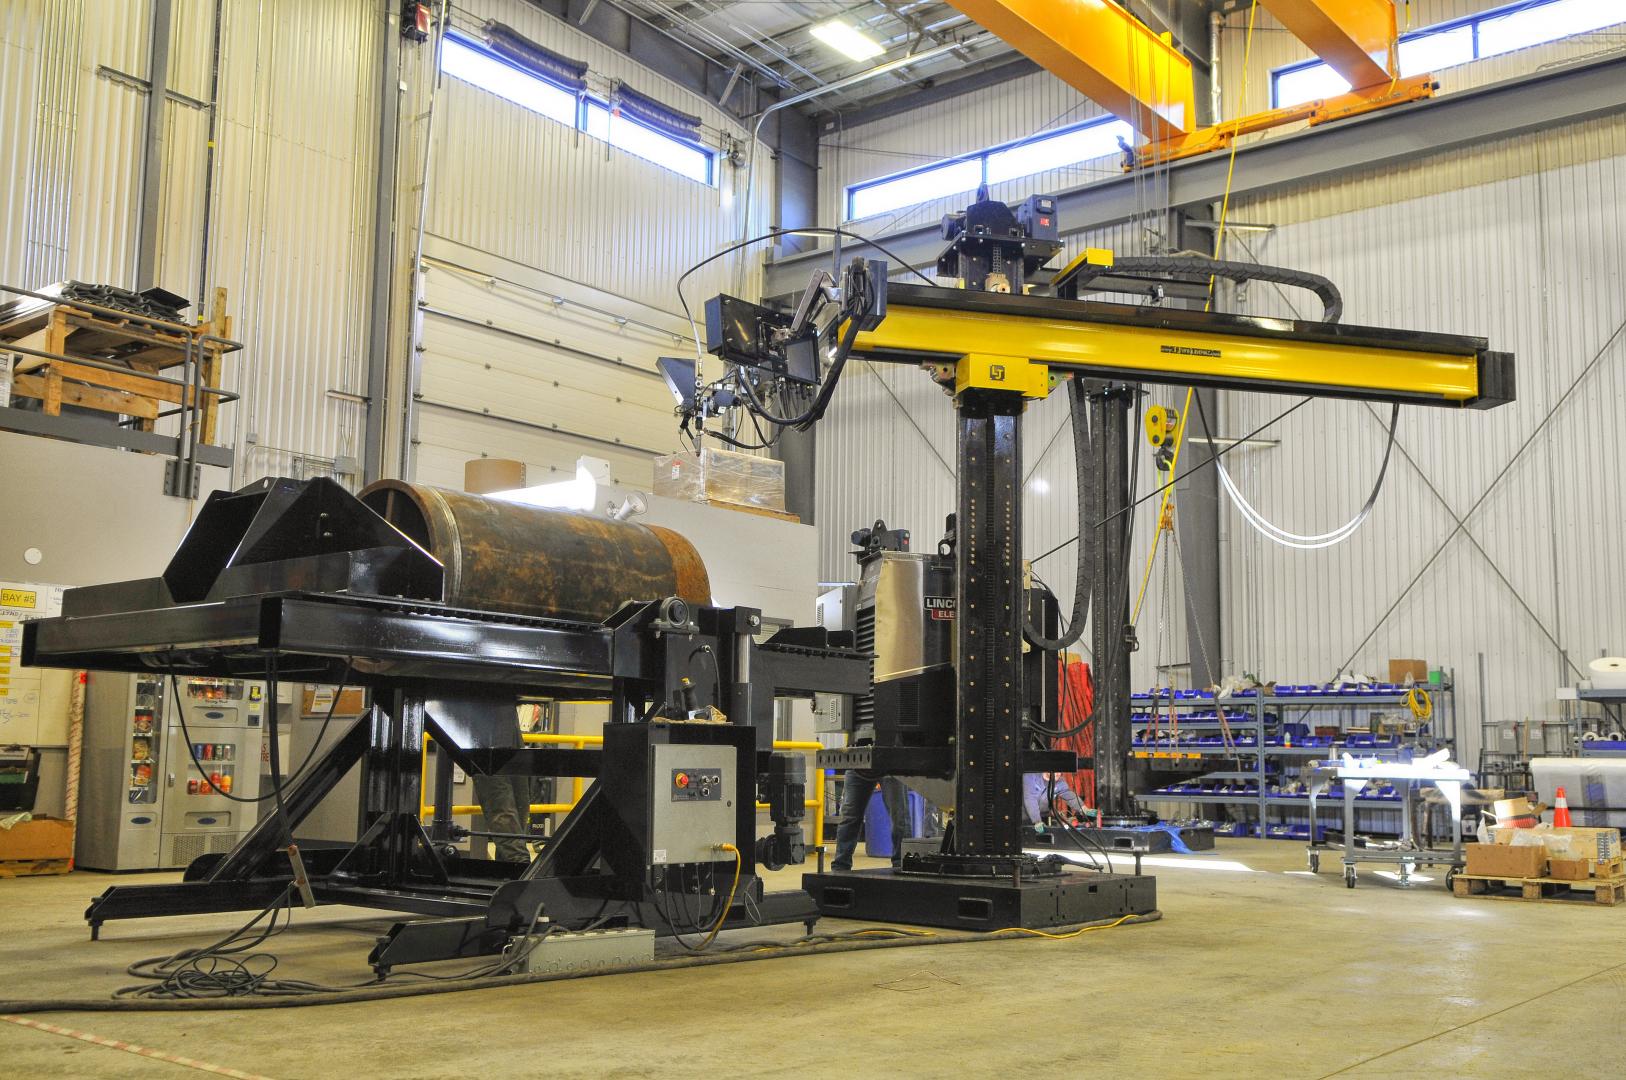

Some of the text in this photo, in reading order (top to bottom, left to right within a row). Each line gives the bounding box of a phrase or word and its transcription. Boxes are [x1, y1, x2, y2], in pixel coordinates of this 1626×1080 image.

[2, 594, 35, 604] BAY #5
[926, 598, 956, 608] LINC
